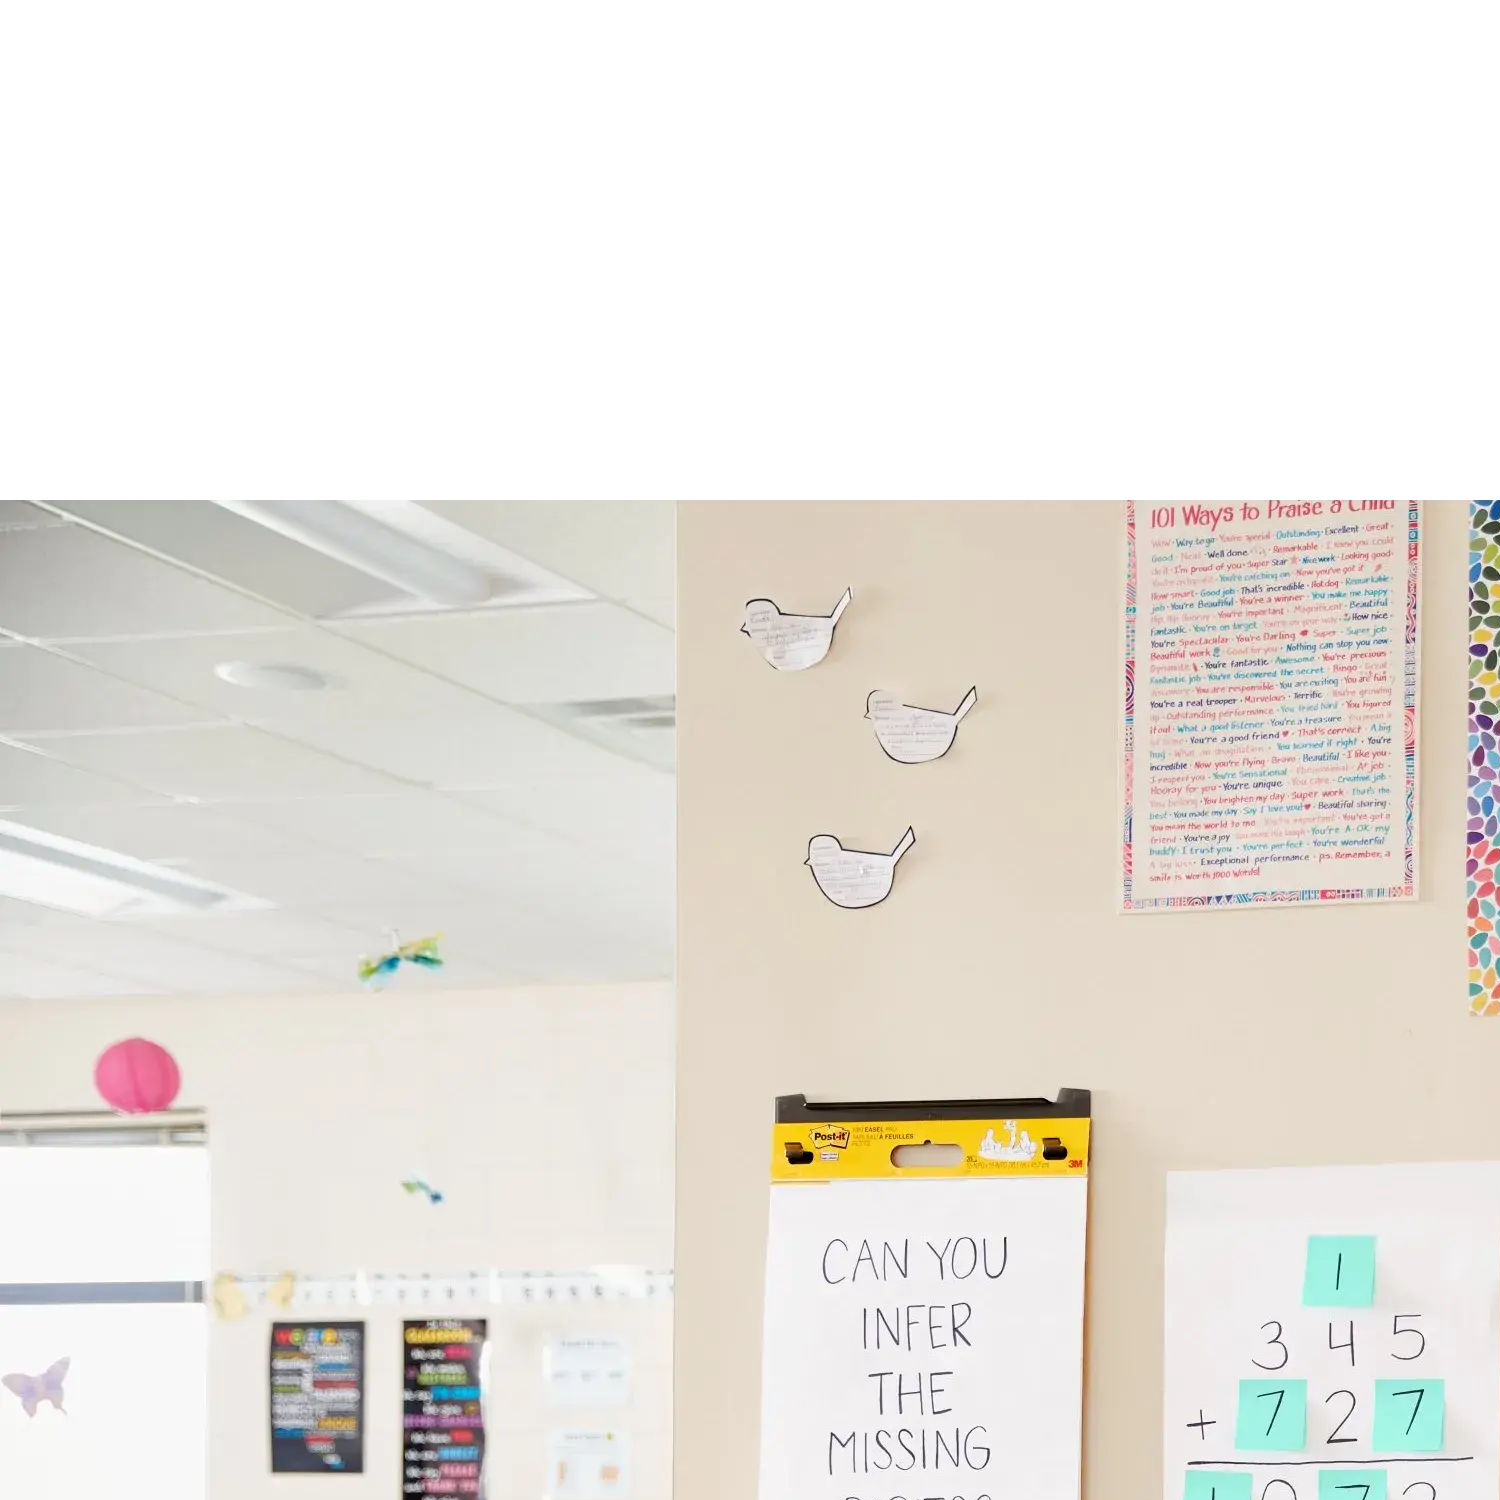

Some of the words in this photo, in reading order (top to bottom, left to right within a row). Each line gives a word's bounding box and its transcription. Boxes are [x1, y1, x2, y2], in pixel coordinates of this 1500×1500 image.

[1151, 508, 1175, 528] 101
[1181, 504, 1234, 531] Ways
[1239, 503, 1260, 520] to
[1268, 499, 1323, 519] Praise
[1330, 499, 1341, 513] a
[1325, 524, 1359, 536] Excellent
[1206, 549, 1225, 559] Well
[1226, 548, 1248, 557] done
[1273, 542, 1318, 554] Remarkable
[1240, 585, 1263, 595] That's
[1266, 581, 1305, 592] incredible
[1286, 642, 1317, 653] Nothing
[1319, 641, 1334, 649] can
[1336, 639, 1354, 650] stop
[1355, 640, 1371, 650] you
[1372, 637, 1388, 645] now
[1204, 661, 1228, 670] You're
[1231, 659, 1269, 668] fantastic
[1190, 735, 1218, 744] You're
[1228, 735, 1249, 744] good
[1251, 731, 1280, 741] friend
[1200, 855, 1249, 866] Exceptional
[1254, 853, 1310, 865] performance
[1150, 873, 1171, 882] smile
[1174, 873, 1182, 881] is
[1185, 870, 1211, 880] worth
[1212, 869, 1231, 879] 1000
[1068, 1160, 1083, 1168] 3M
[823, 1238, 908, 1284] CAN
[927, 1236, 1008, 1281] YOU
[863, 1302, 972, 1351] INFER
[868, 1371, 954, 1416] THE
[828, 1425, 991, 1476] MISSING
